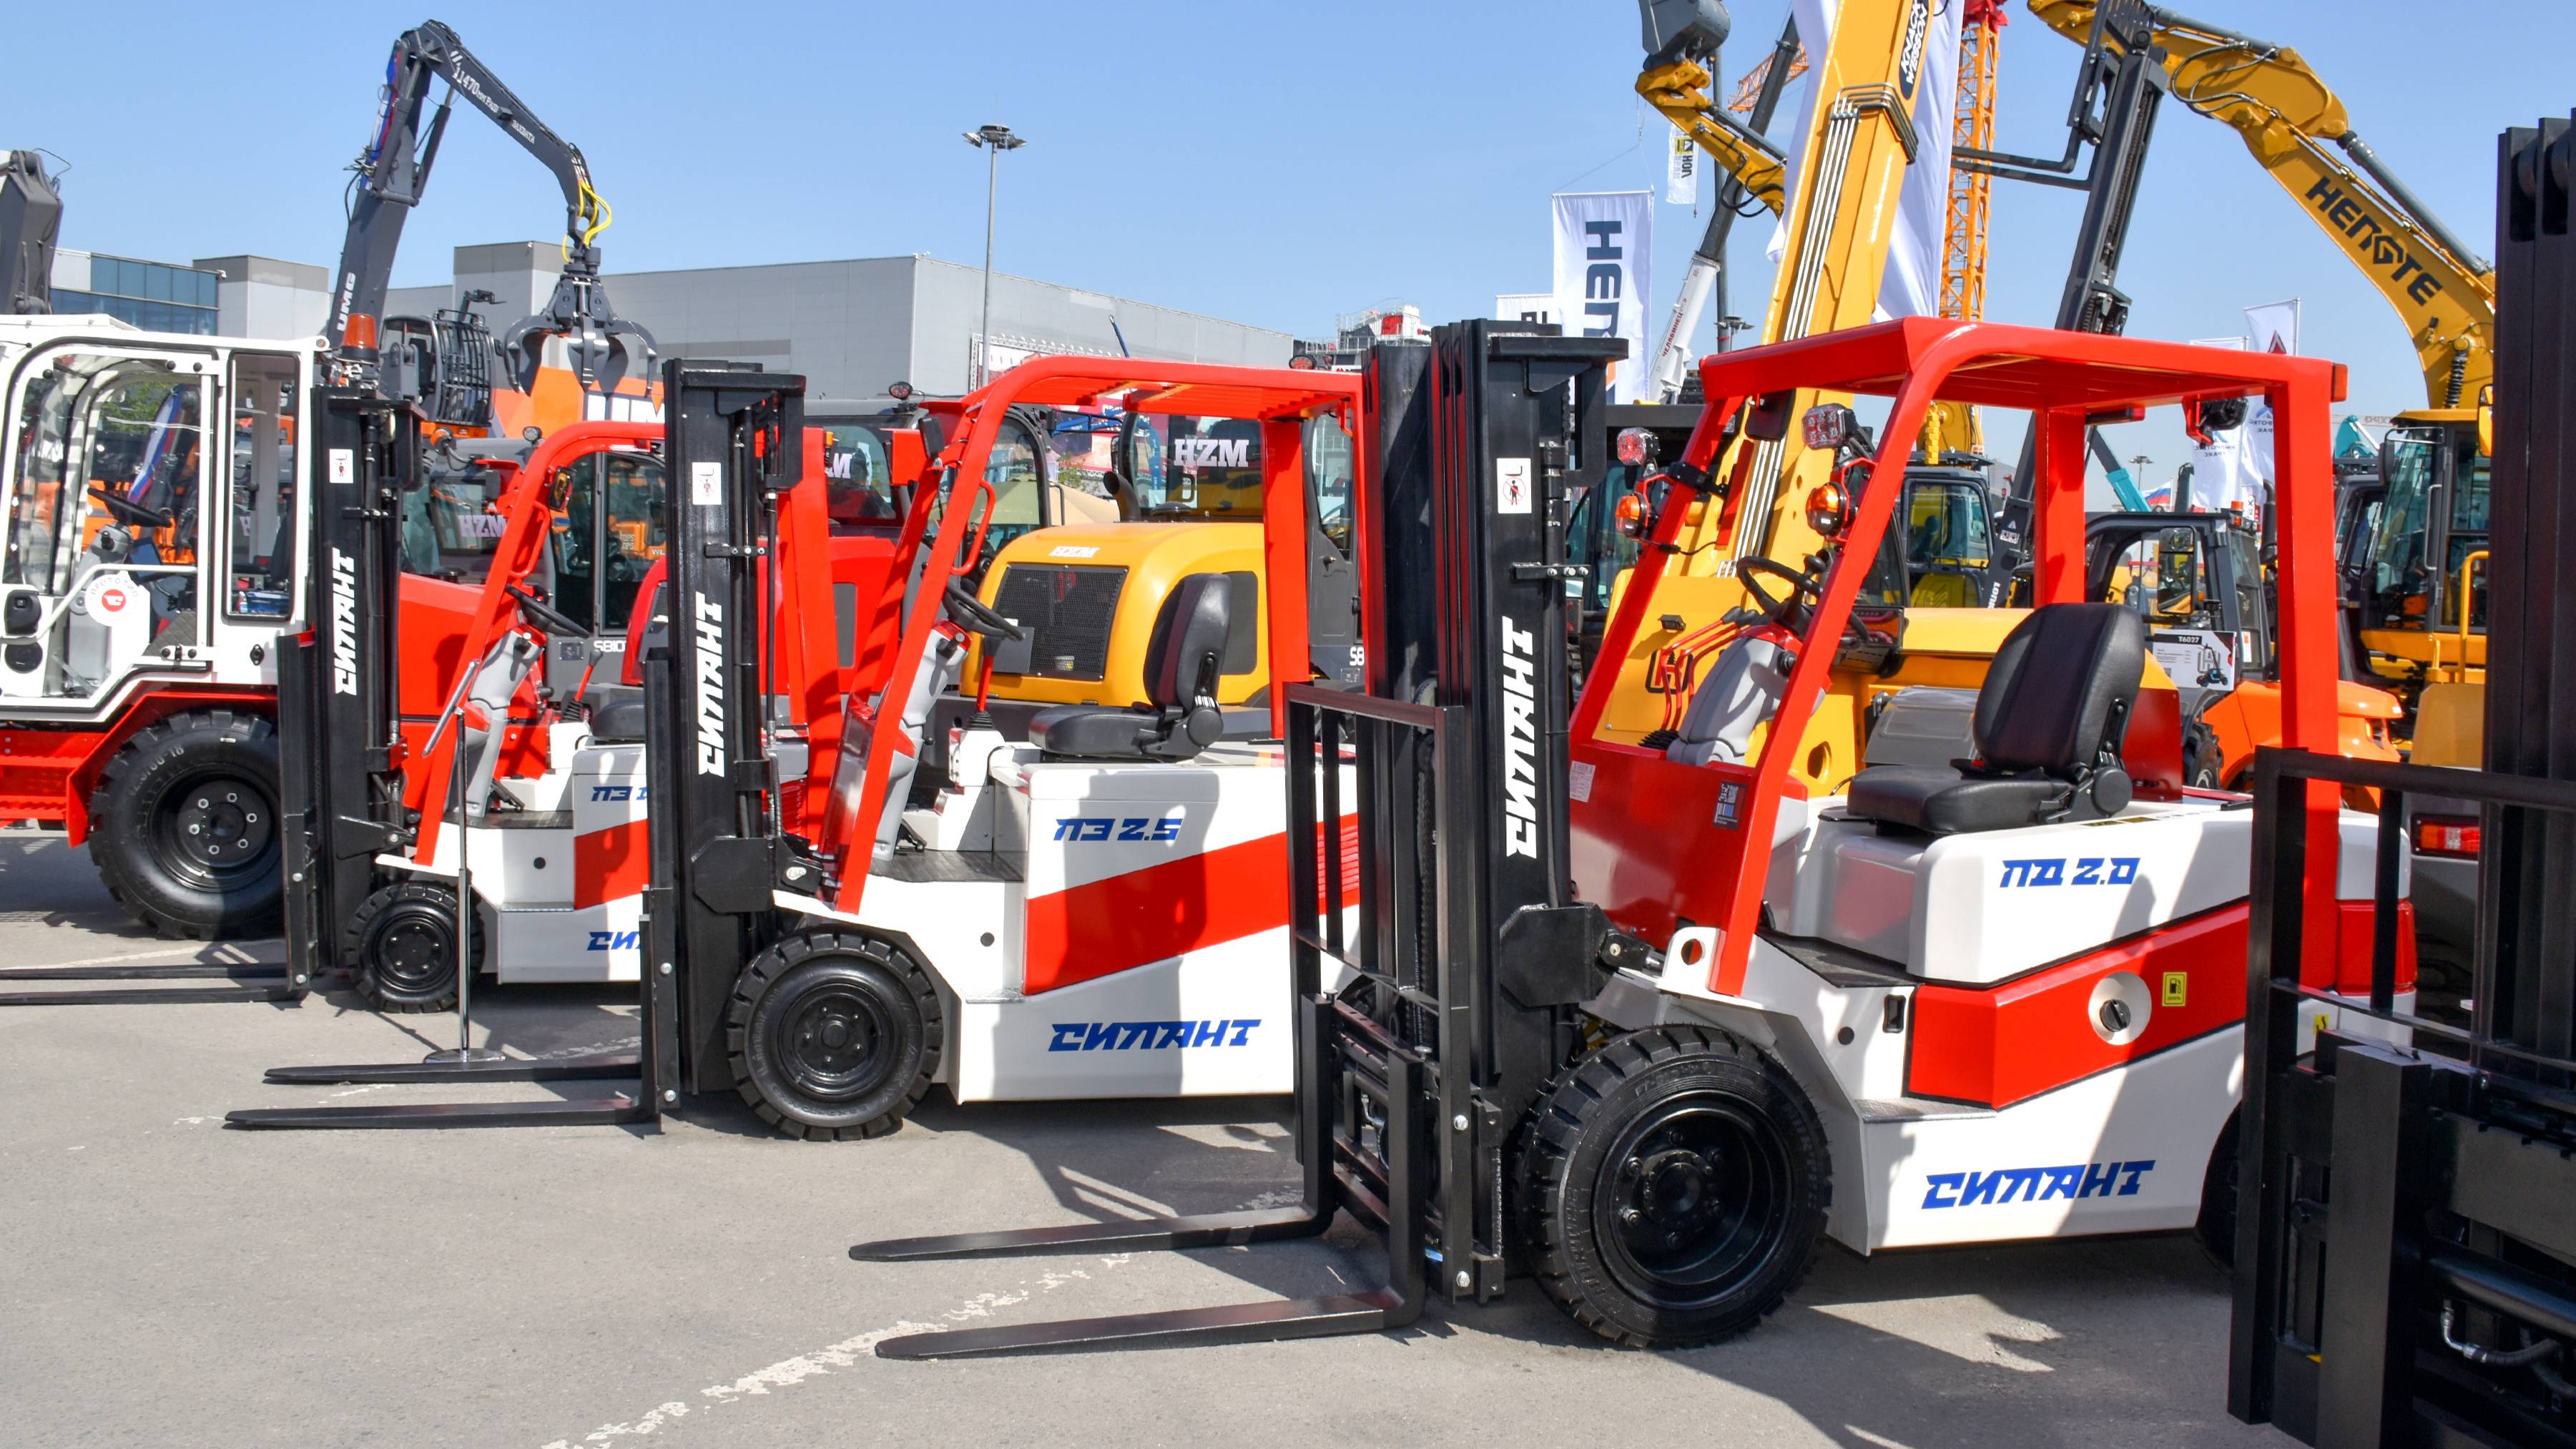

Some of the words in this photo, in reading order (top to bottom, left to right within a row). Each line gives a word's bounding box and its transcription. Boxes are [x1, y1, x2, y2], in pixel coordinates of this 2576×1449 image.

[1901, 0, 1921, 74] KNACK
[1906, 3, 1927, 84] WESSON
[2305, 176, 2443, 306] HENGTE
[337, 272, 356, 331] UMG
[1174, 438, 1249, 467] HZM
[1049, 546, 1101, 558] HZM
[333, 548, 357, 695] СИЛАНТ
[696, 591, 724, 777] СИЛАНТ
[1502, 616, 1537, 859] СИЛАНТ
[1117, 818, 1183, 841] 2.5
[1048, 1019, 1262, 1053] СИЛАНТ
[1921, 1159, 2155, 1209] СИЛАНТ
